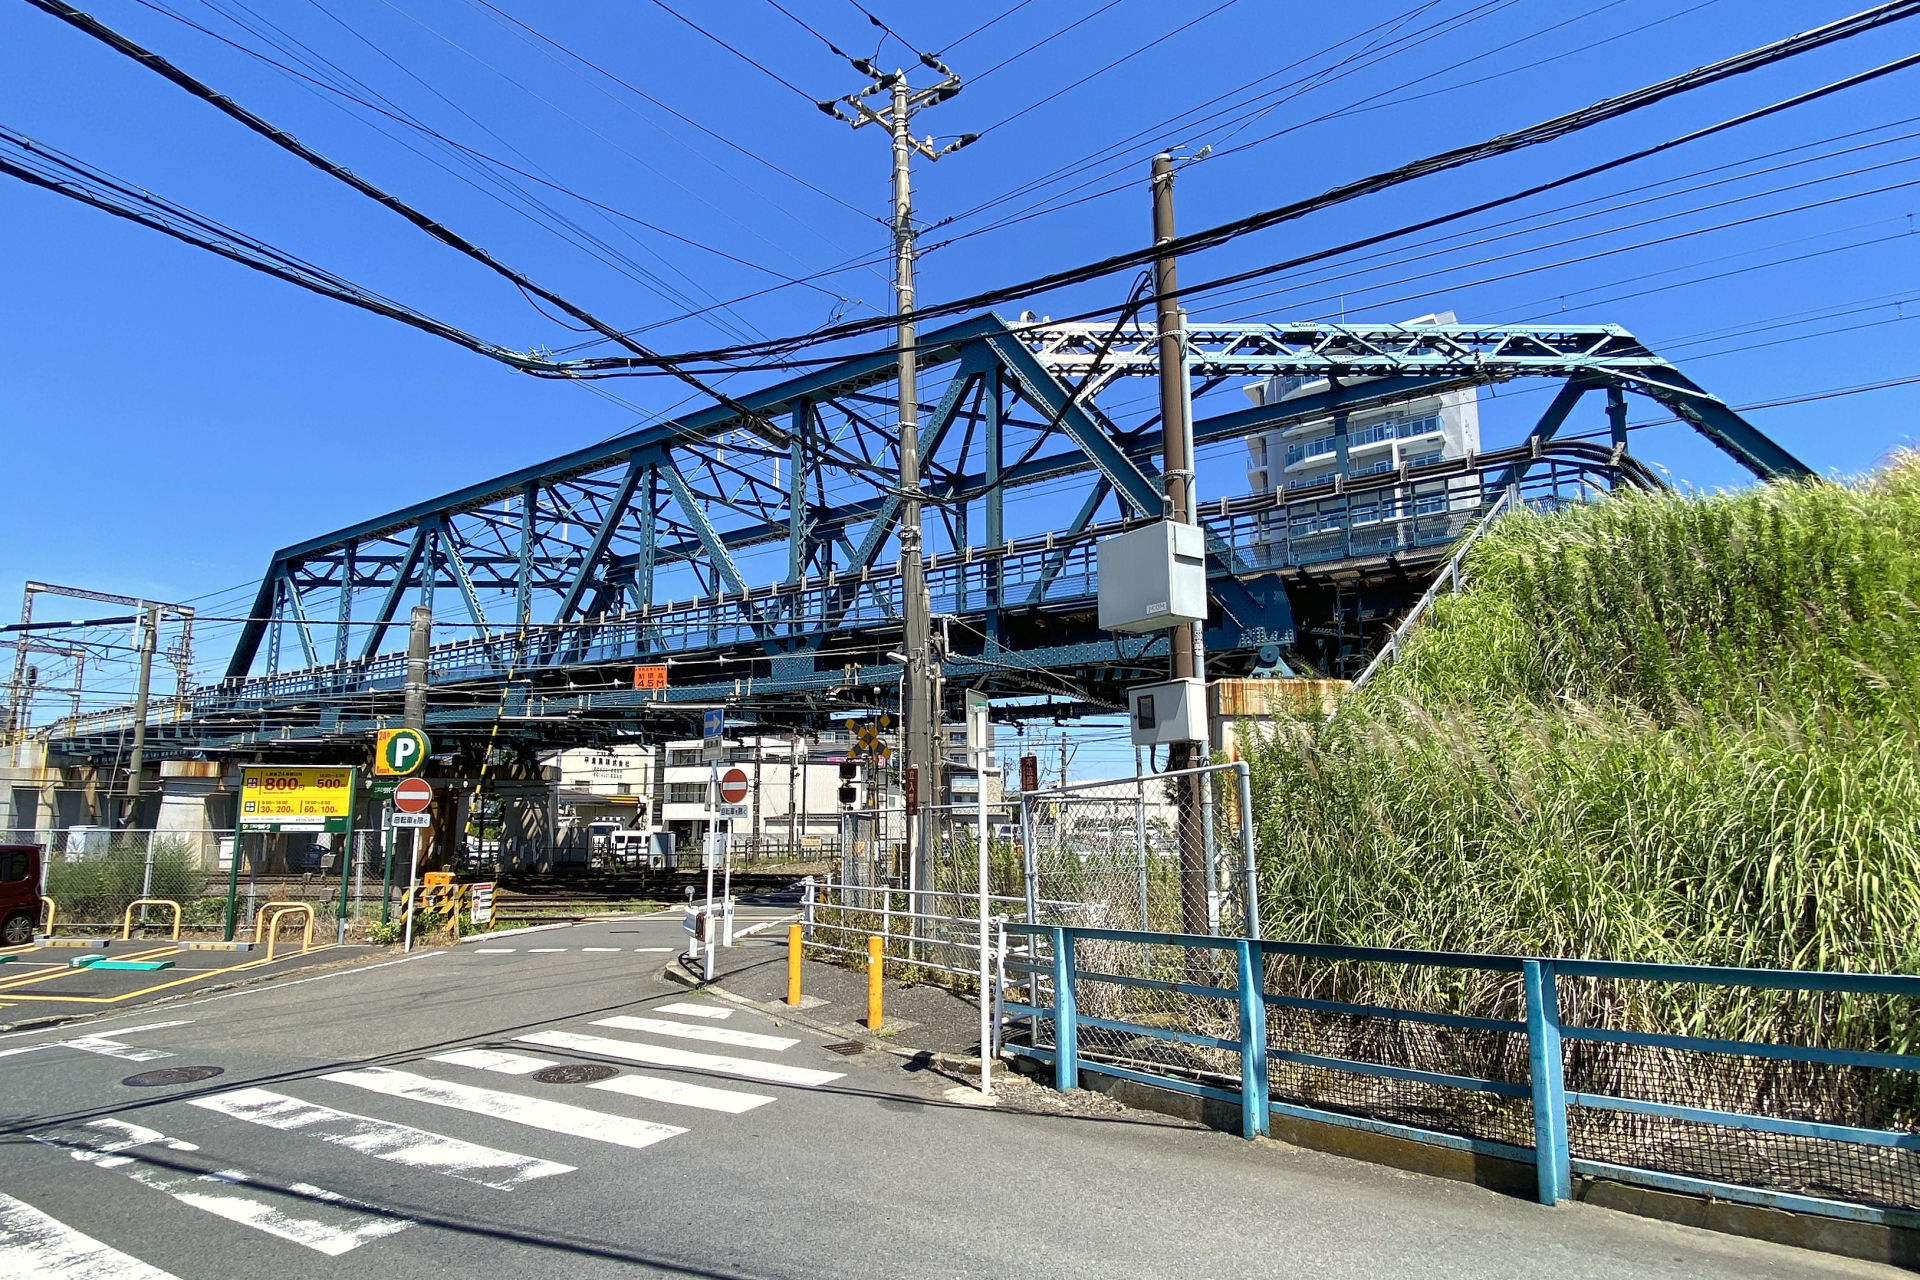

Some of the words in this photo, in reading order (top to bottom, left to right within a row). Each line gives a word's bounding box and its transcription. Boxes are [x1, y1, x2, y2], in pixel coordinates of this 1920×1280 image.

[394, 737, 416, 767] P
[720, 807, 747, 815] 自転車を除く
[393, 816, 428, 825] 自転車を除く
